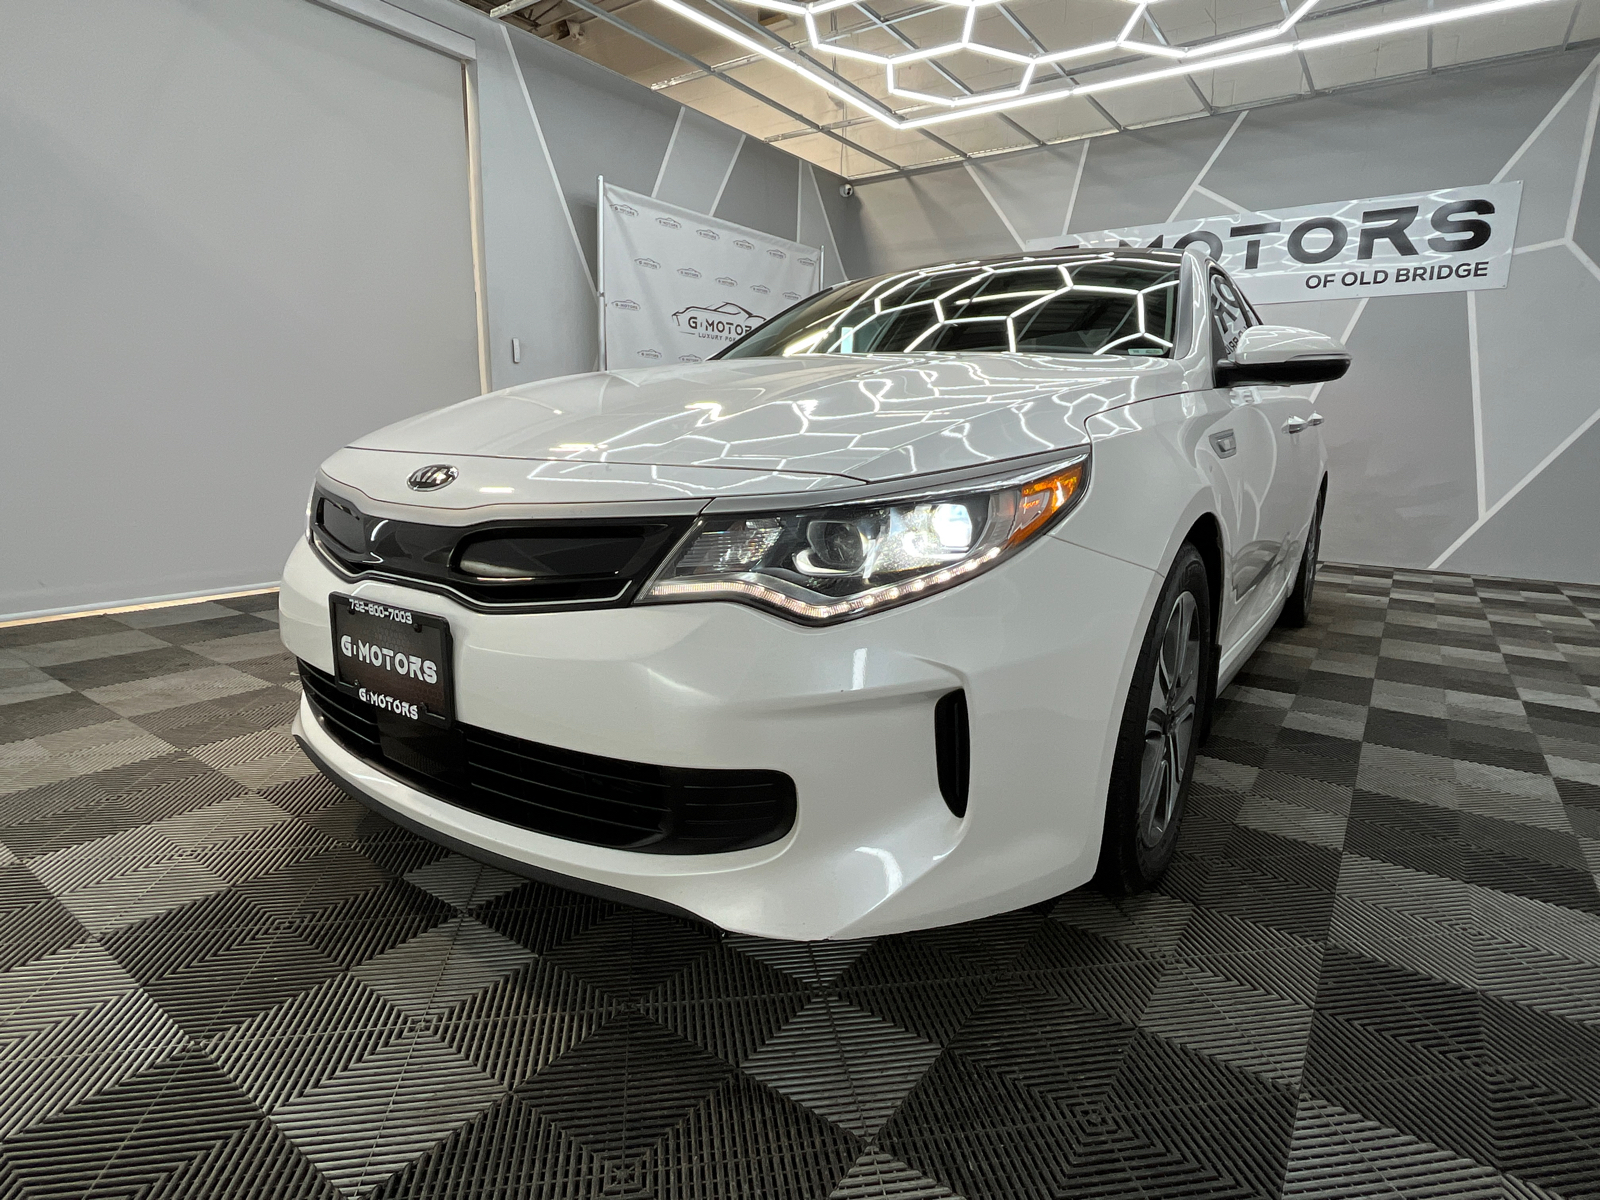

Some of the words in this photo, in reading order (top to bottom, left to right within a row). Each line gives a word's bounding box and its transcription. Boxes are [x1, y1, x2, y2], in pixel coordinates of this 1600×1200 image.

[1119, 199, 1495, 270] OTORS
[1305, 274, 1336, 289] OF
[1341, 269, 1389, 287] OLD
[1395, 261, 1489, 283] BRIDGE
[698, 332, 722, 341] LUXURY
[410, 467, 448, 484] KIA
[349, 598, 413, 624] 732-800-7003
